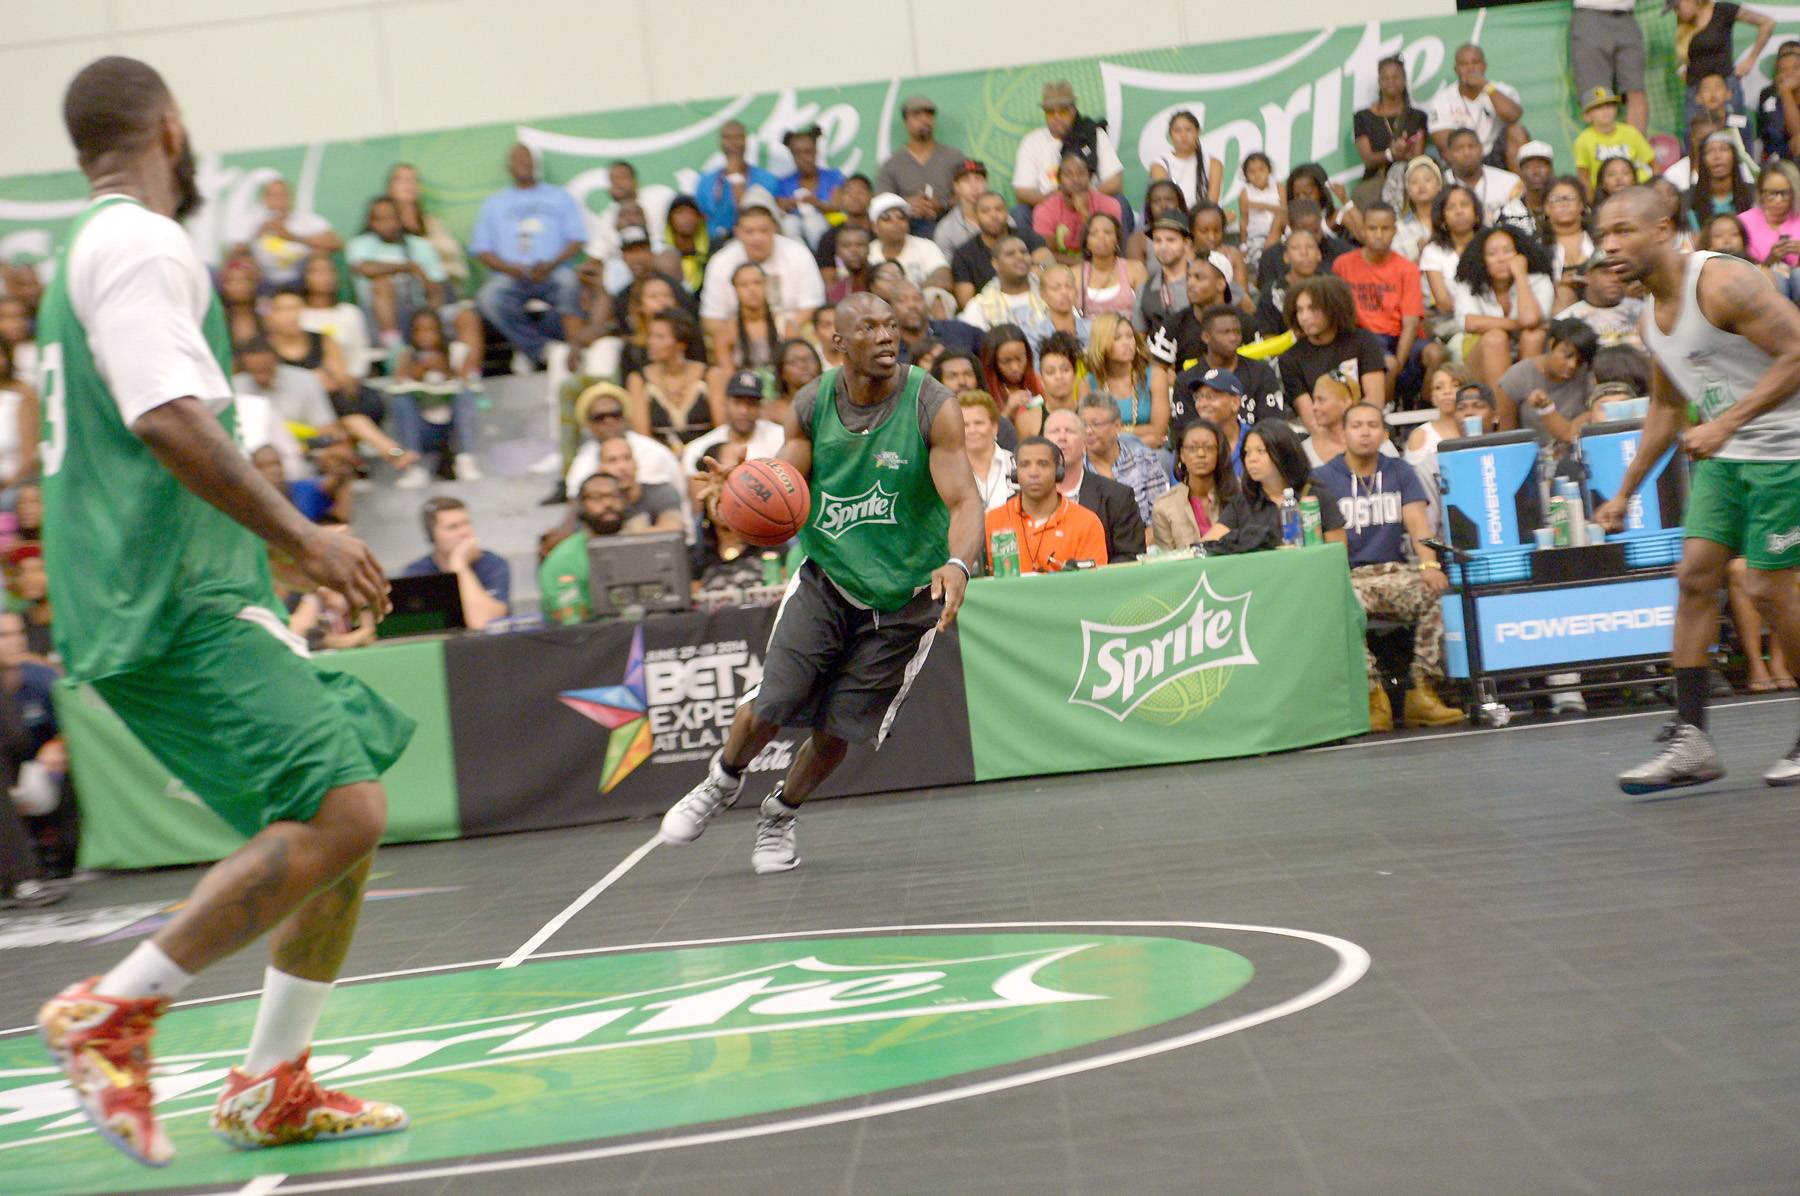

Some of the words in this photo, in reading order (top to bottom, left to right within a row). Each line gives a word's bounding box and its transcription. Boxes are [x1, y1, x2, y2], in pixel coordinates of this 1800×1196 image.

[822, 491, 889, 531] Sprite
[1495, 605, 1676, 643] POWERADE
[1091, 597, 1234, 703] Sprite
[645, 651, 749, 705] BET
